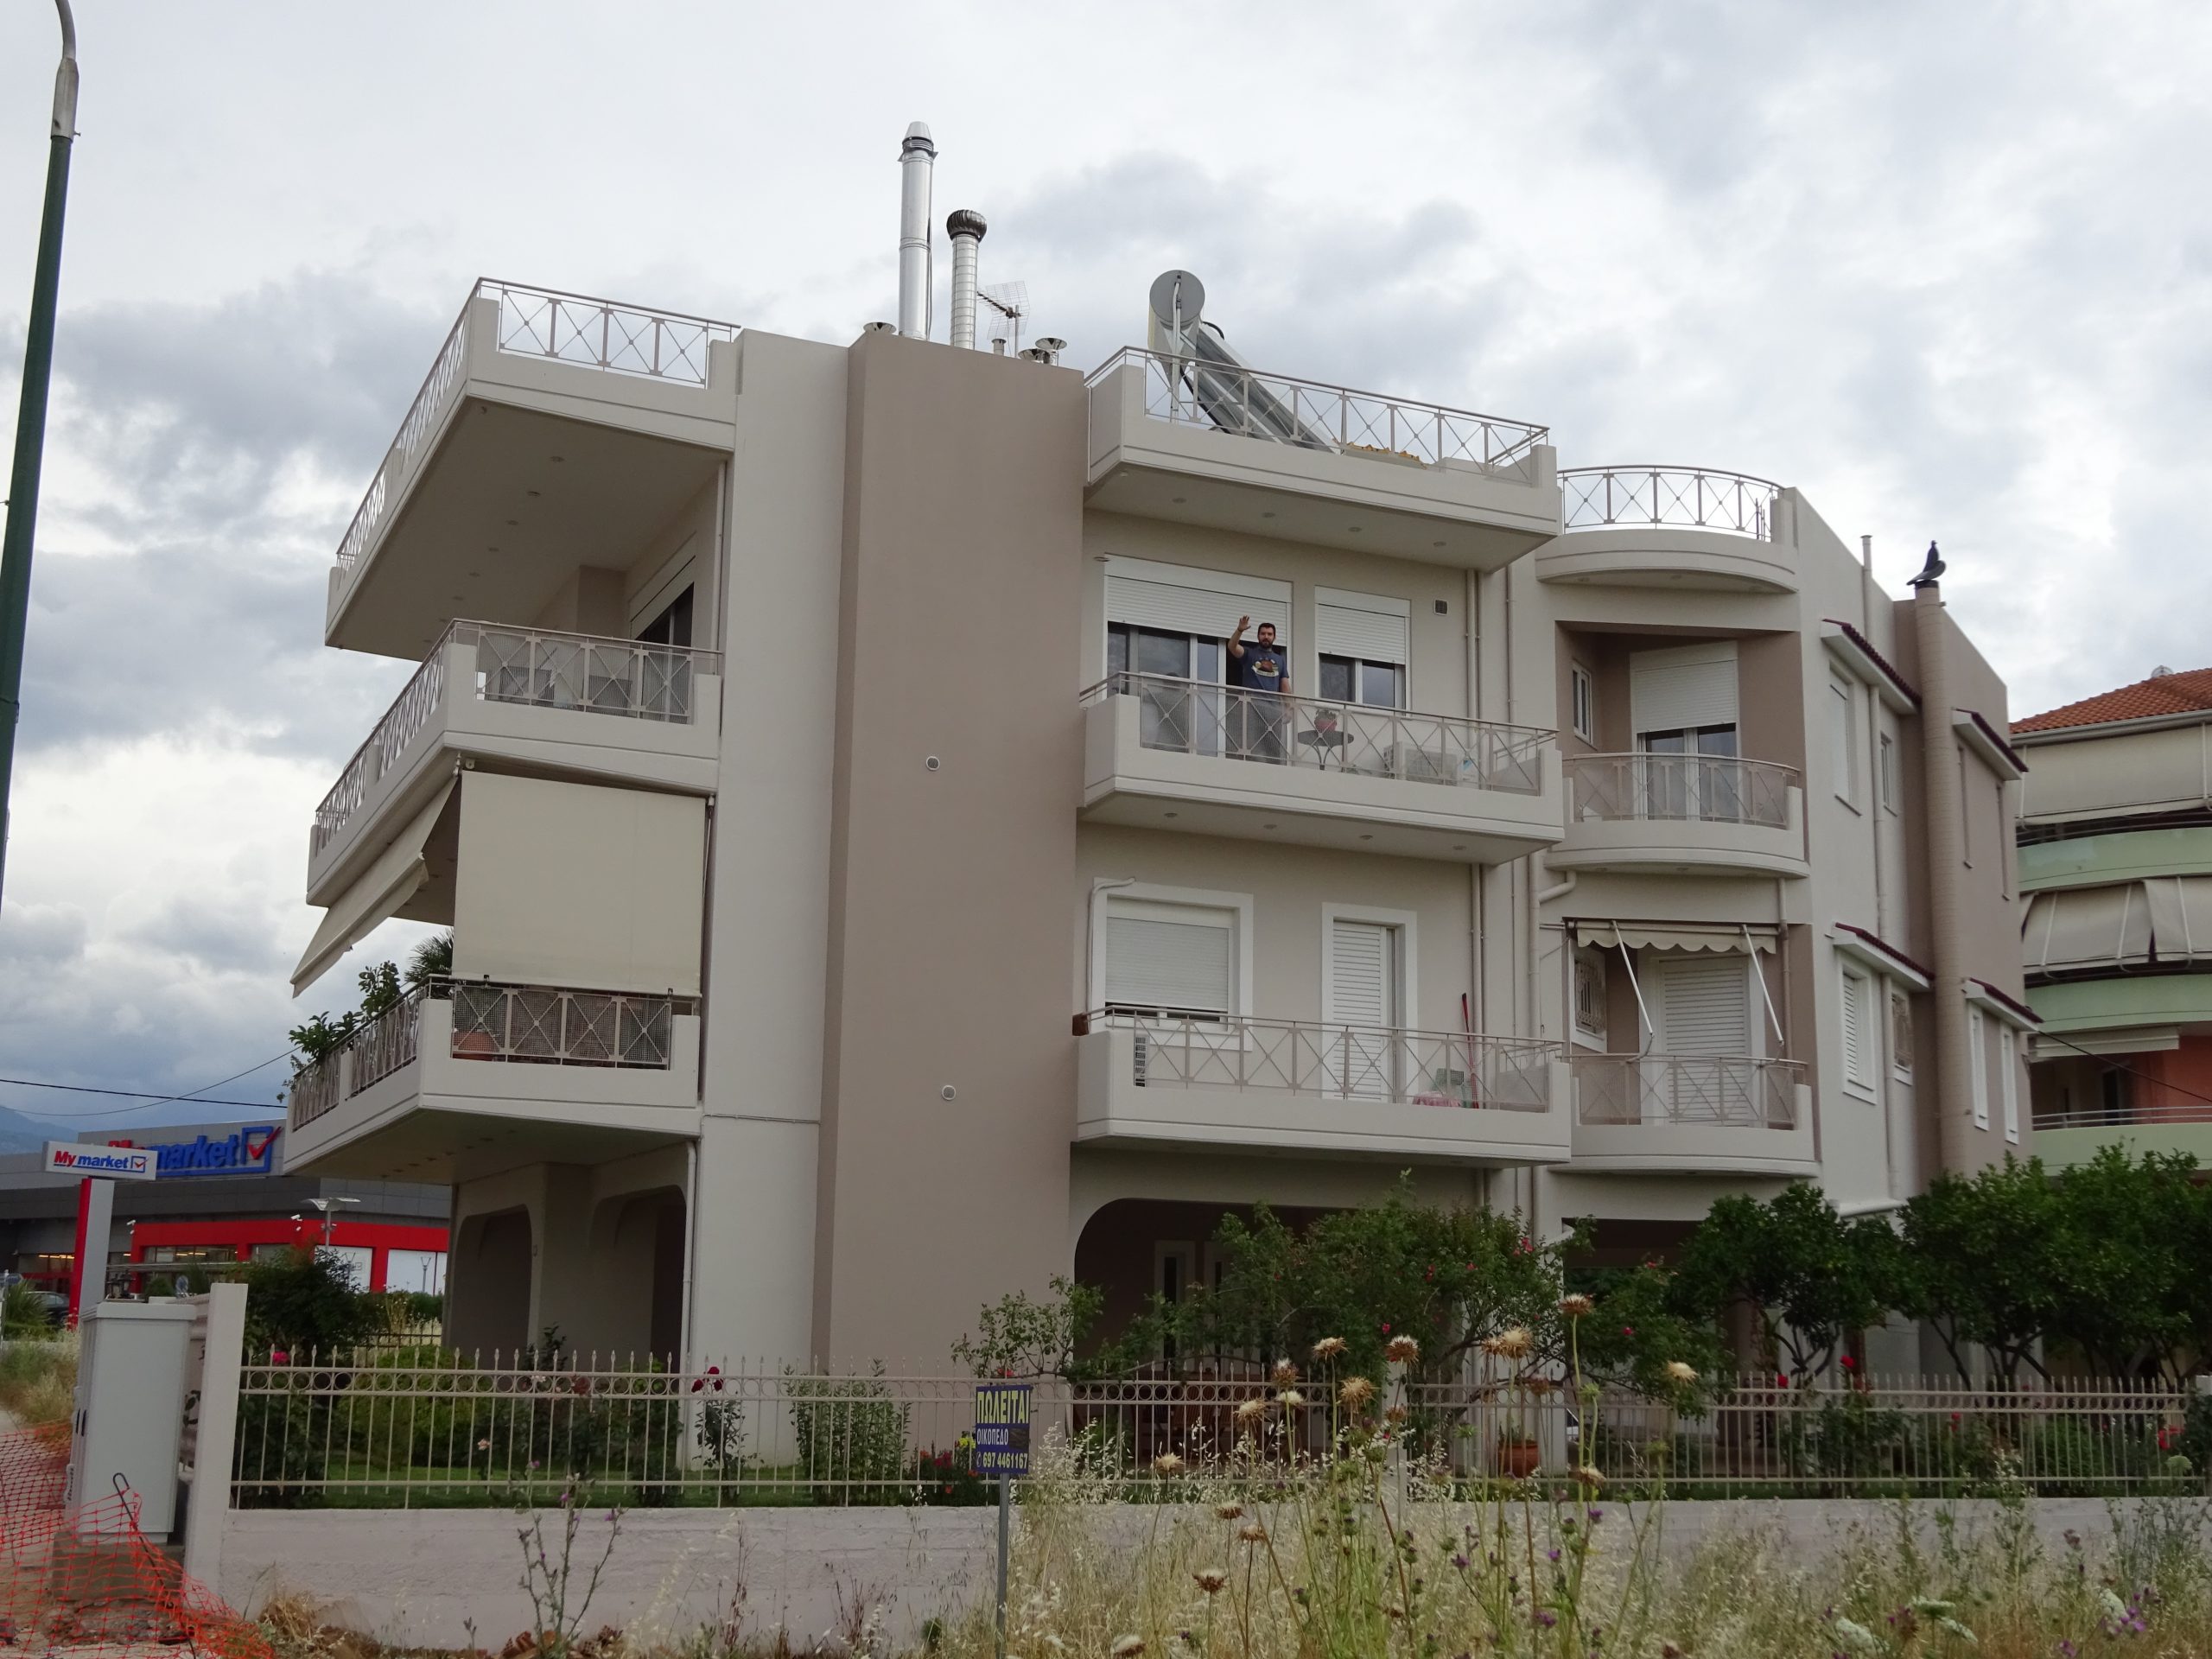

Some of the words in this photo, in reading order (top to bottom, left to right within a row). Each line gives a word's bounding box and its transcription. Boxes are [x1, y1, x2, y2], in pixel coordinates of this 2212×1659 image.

[54, 1150, 77, 1167] My
[77, 1154, 129, 1169] market
[977, 1390, 1029, 1423] ΠΩΛΕΙΤΑΙ
[977, 1428, 1008, 1445] ΟΙΚΟΠΕΔΟ
[982, 1452, 996, 1468] 697
